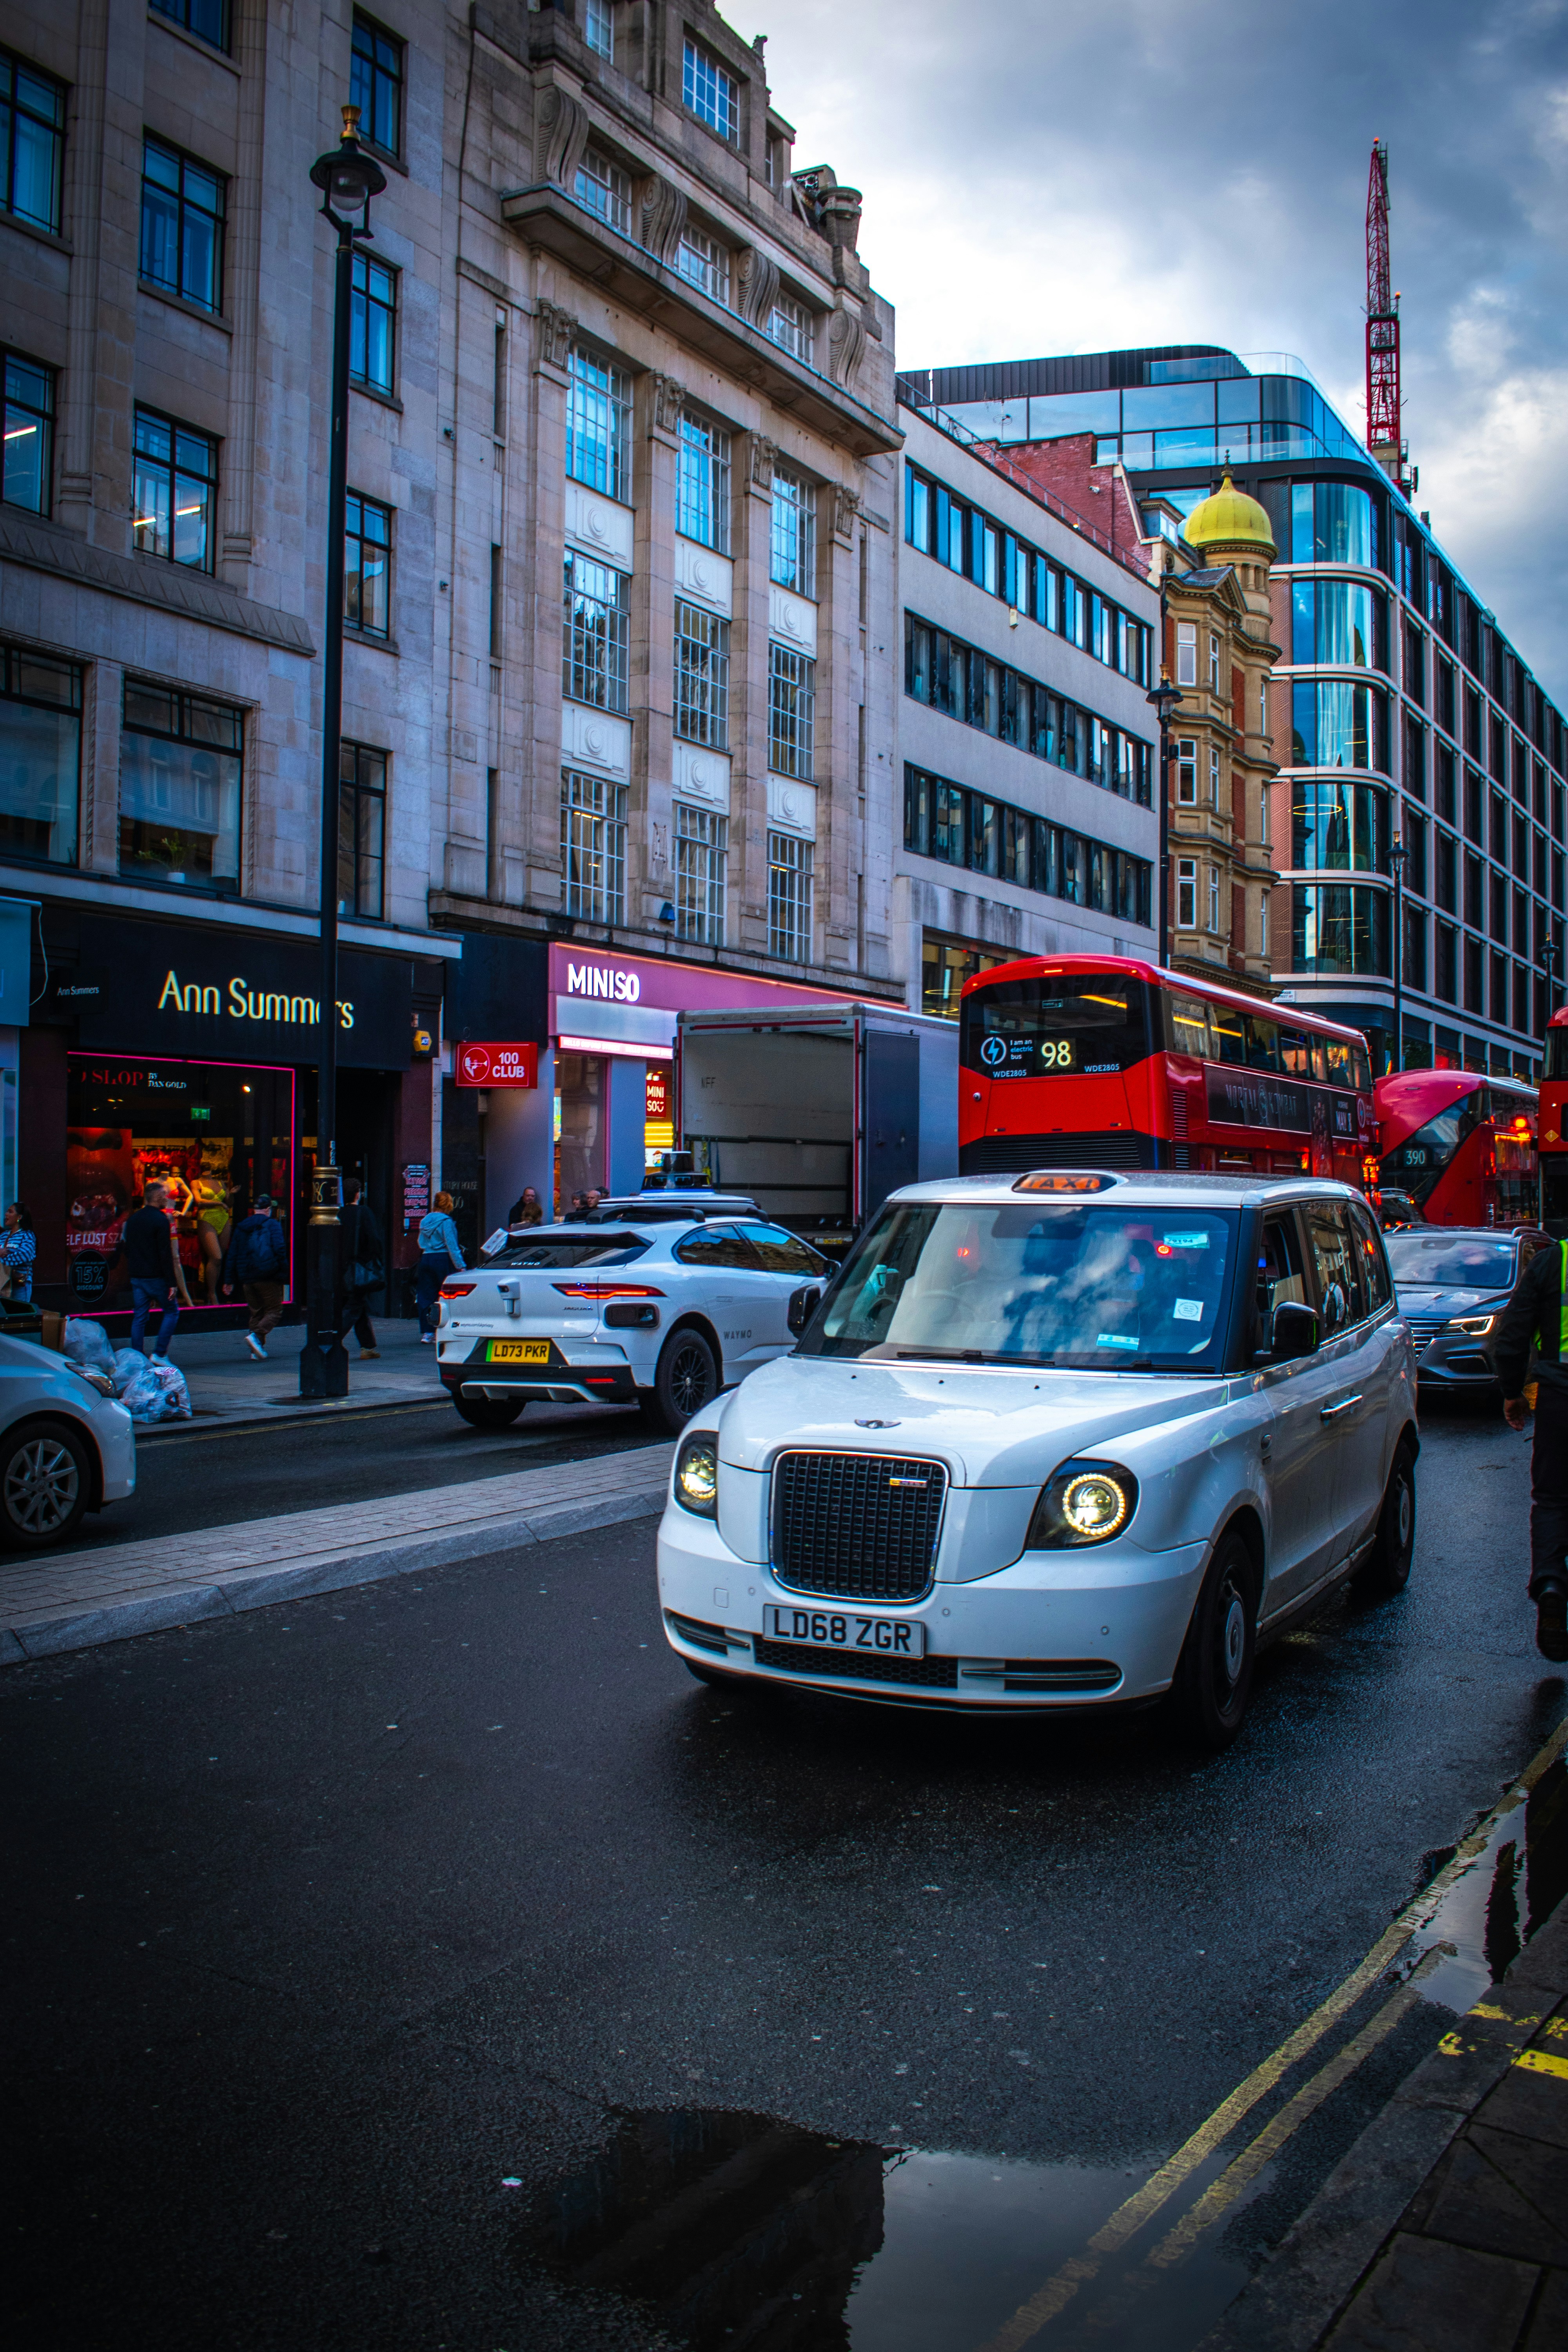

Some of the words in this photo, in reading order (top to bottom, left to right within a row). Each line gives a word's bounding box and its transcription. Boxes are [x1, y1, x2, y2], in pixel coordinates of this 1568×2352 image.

[567, 963, 640, 1002] MINISO
[57, 986, 69, 996] Ann
[71, 985, 100, 995] Summers
[158, 971, 221, 1015] Ann
[228, 977, 355, 1029] Summs
[563, 1039, 580, 1047] HELLO
[581, 1041, 601, 1049] OXFORD
[602, 1043, 621, 1051] STREET
[641, 1047, 660, 1056] OXFORD
[1041, 1040, 1072, 1067] 98
[498, 1052, 519, 1064] 100
[492, 1065, 524, 1078] CLUB
[993, 1069, 1027, 1078] WDE2805
[1084, 1063, 1120, 1073] WDE2805
[91, 1069, 144, 1086] SLOP
[647, 1085, 664, 1098] MINI
[1405, 1150, 1425, 1165] 390
[1029, 1178, 1093, 1188] TAXI
[82, 1233, 107, 1246] LUST
[108, 1233, 122, 1244] SZ
[75, 1266, 105, 1284] 15%
[724, 1330, 752, 1340] WAYMO
[494, 1345, 522, 1357] LD73
[525, 1345, 548, 1358] PKR
[774, 1608, 847, 1643] LD68
[856, 1618, 911, 1652] ZGR
